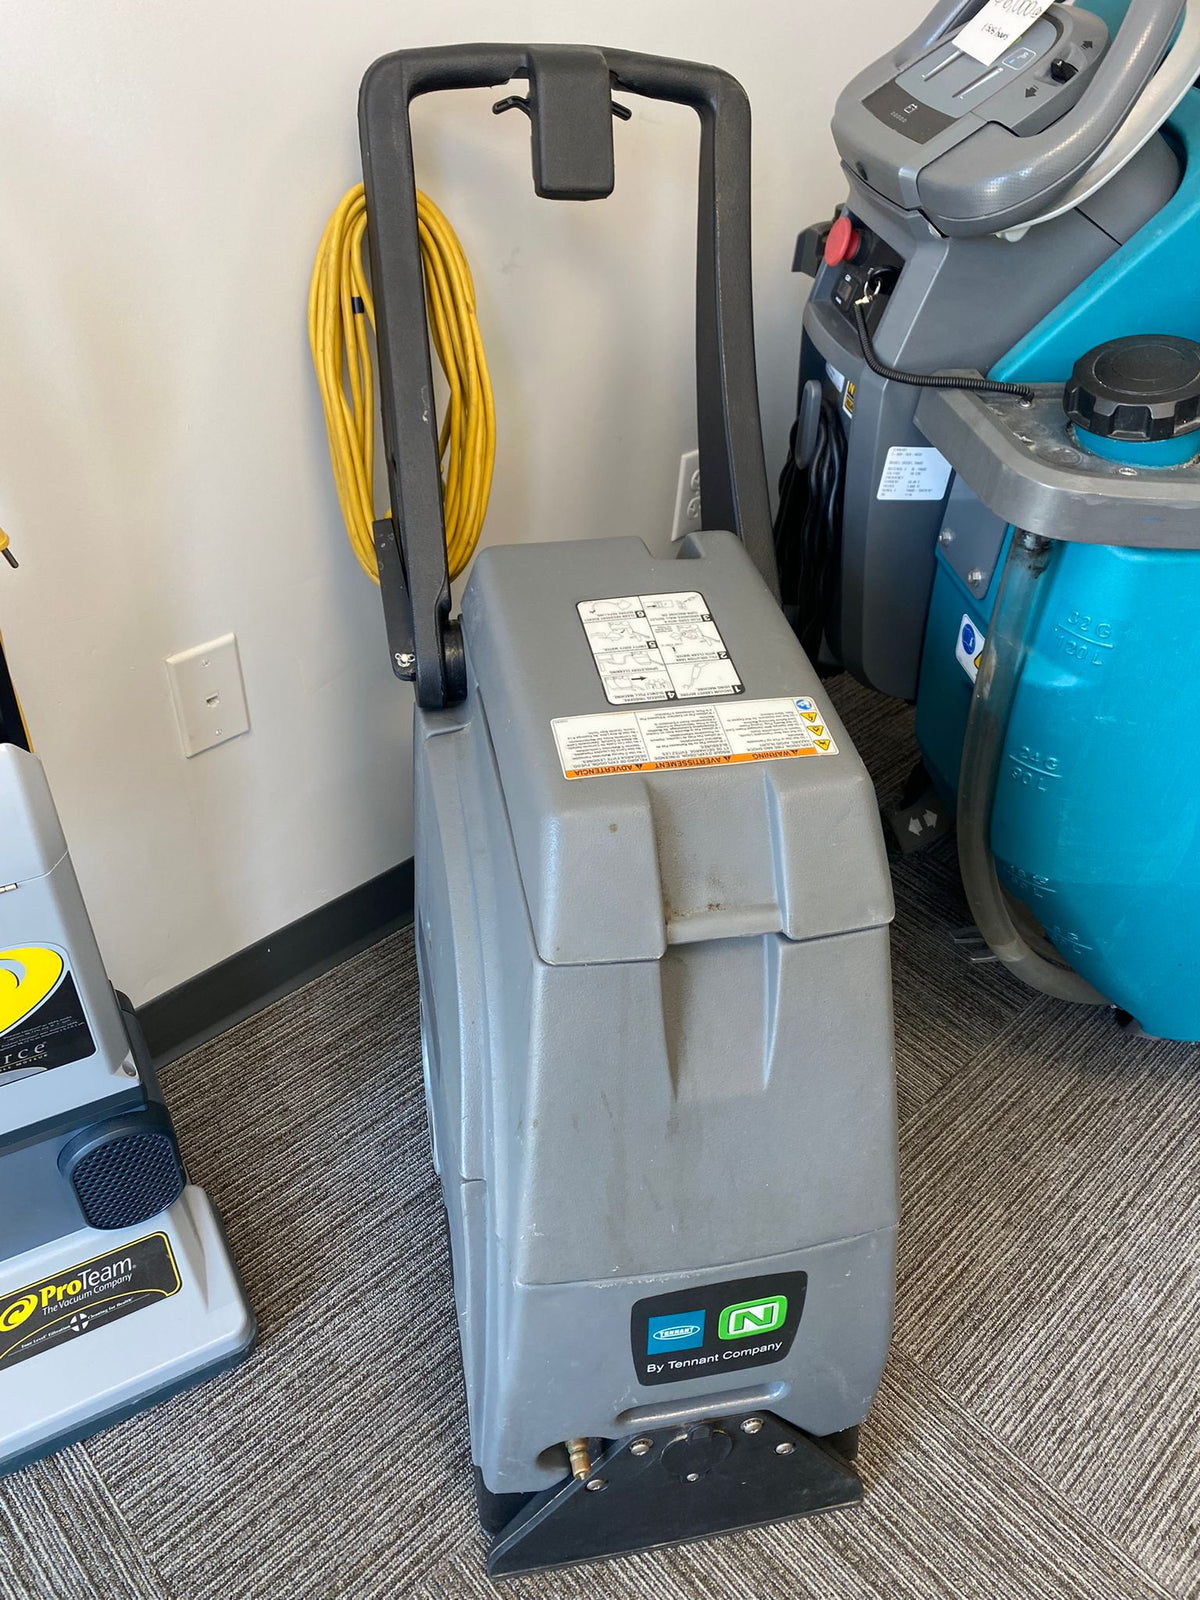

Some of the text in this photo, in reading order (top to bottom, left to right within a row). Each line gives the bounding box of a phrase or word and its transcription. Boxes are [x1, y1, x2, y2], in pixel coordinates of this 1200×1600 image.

[1067, 610, 1112, 638] 32 G
[720, 651, 728, 659] 2
[1091, 649, 1103, 665] L
[733, 685, 741, 693] 1
[752, 750, 791, 760] WARNING
[574, 764, 633, 776] ADVERTENCIA
[655, 757, 721, 769] AVERTISSEMENT
[1045, 756, 1058, 771] G
[1037, 777, 1047, 792] L
[42, 1272, 132, 1316] The Vacuum Company
[730, 1303, 777, 1333] N
[658, 1326, 695, 1338] TENNANT
[647, 1341, 783, 1373] By Tennant Company
